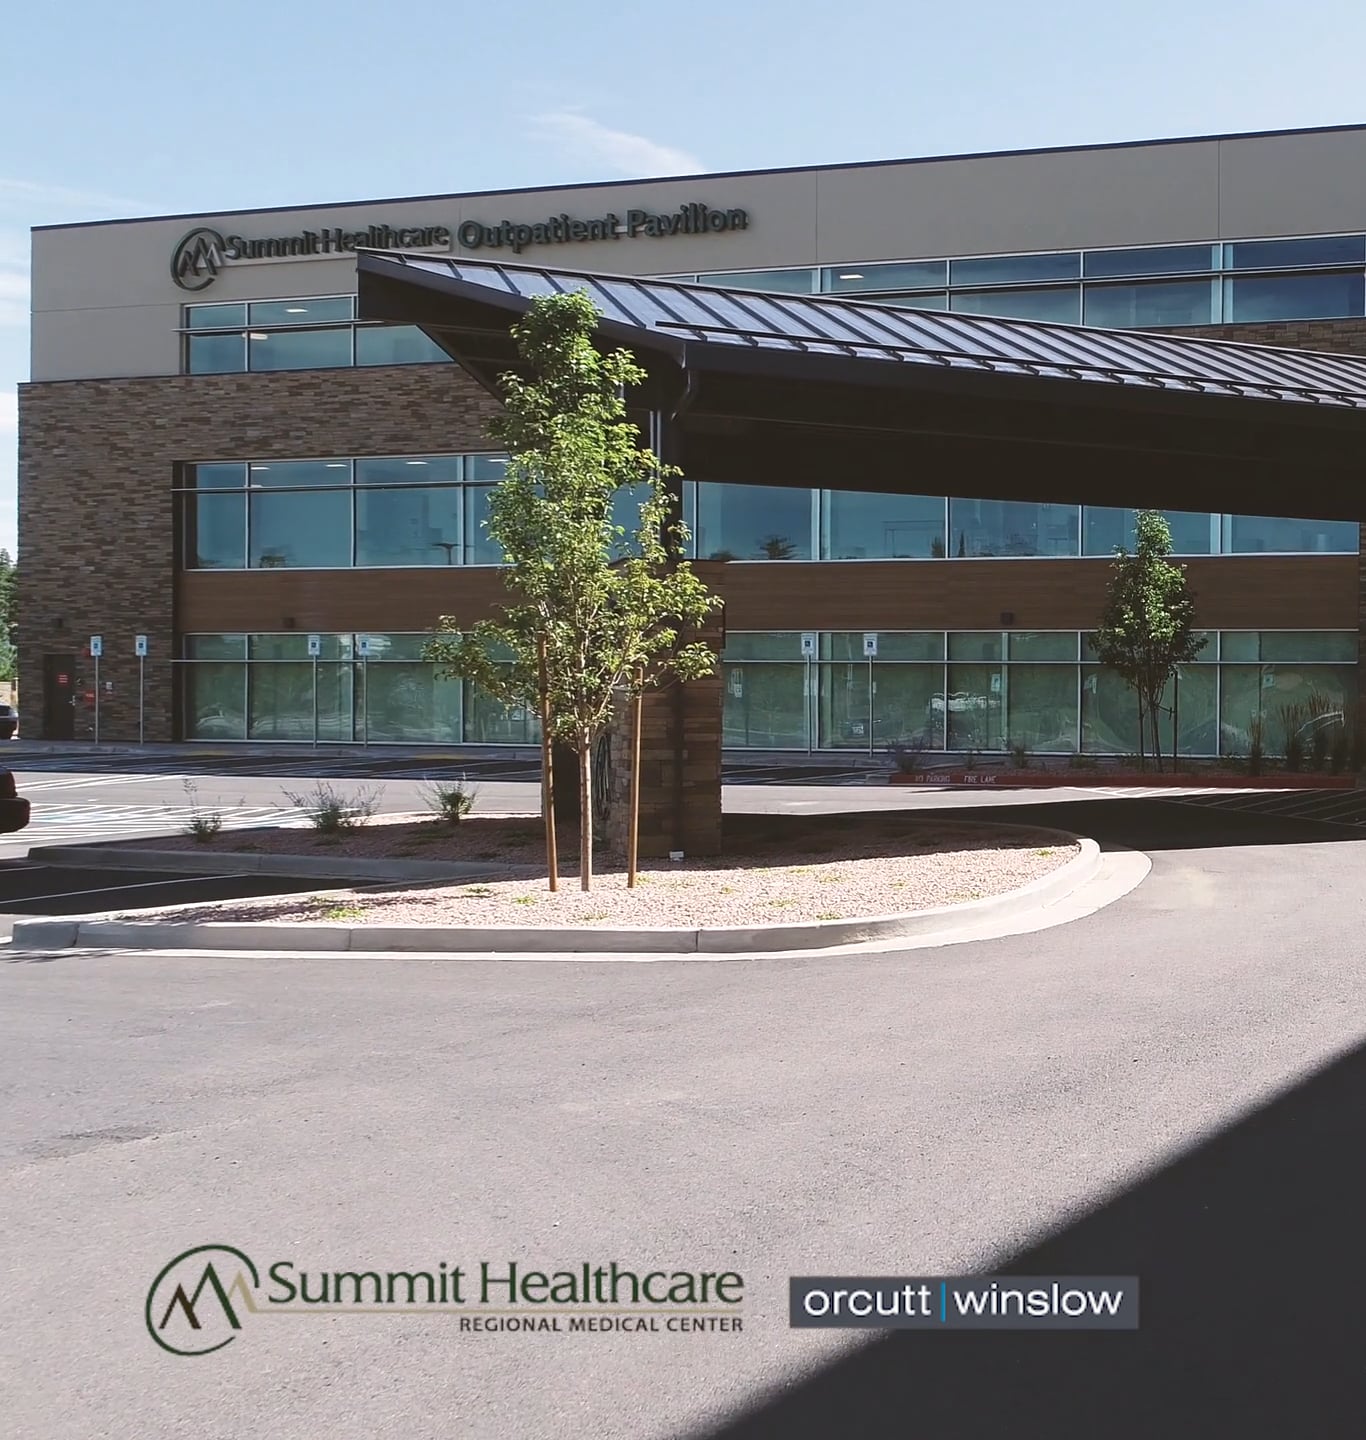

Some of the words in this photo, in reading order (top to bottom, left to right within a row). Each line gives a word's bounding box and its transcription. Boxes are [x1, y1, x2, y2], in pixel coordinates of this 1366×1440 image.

[225, 230, 320, 259] Summit
[321, 224, 449, 253] Healthcare
[457, 213, 619, 253] Outpatient
[626, 202, 749, 238] Pavilion
